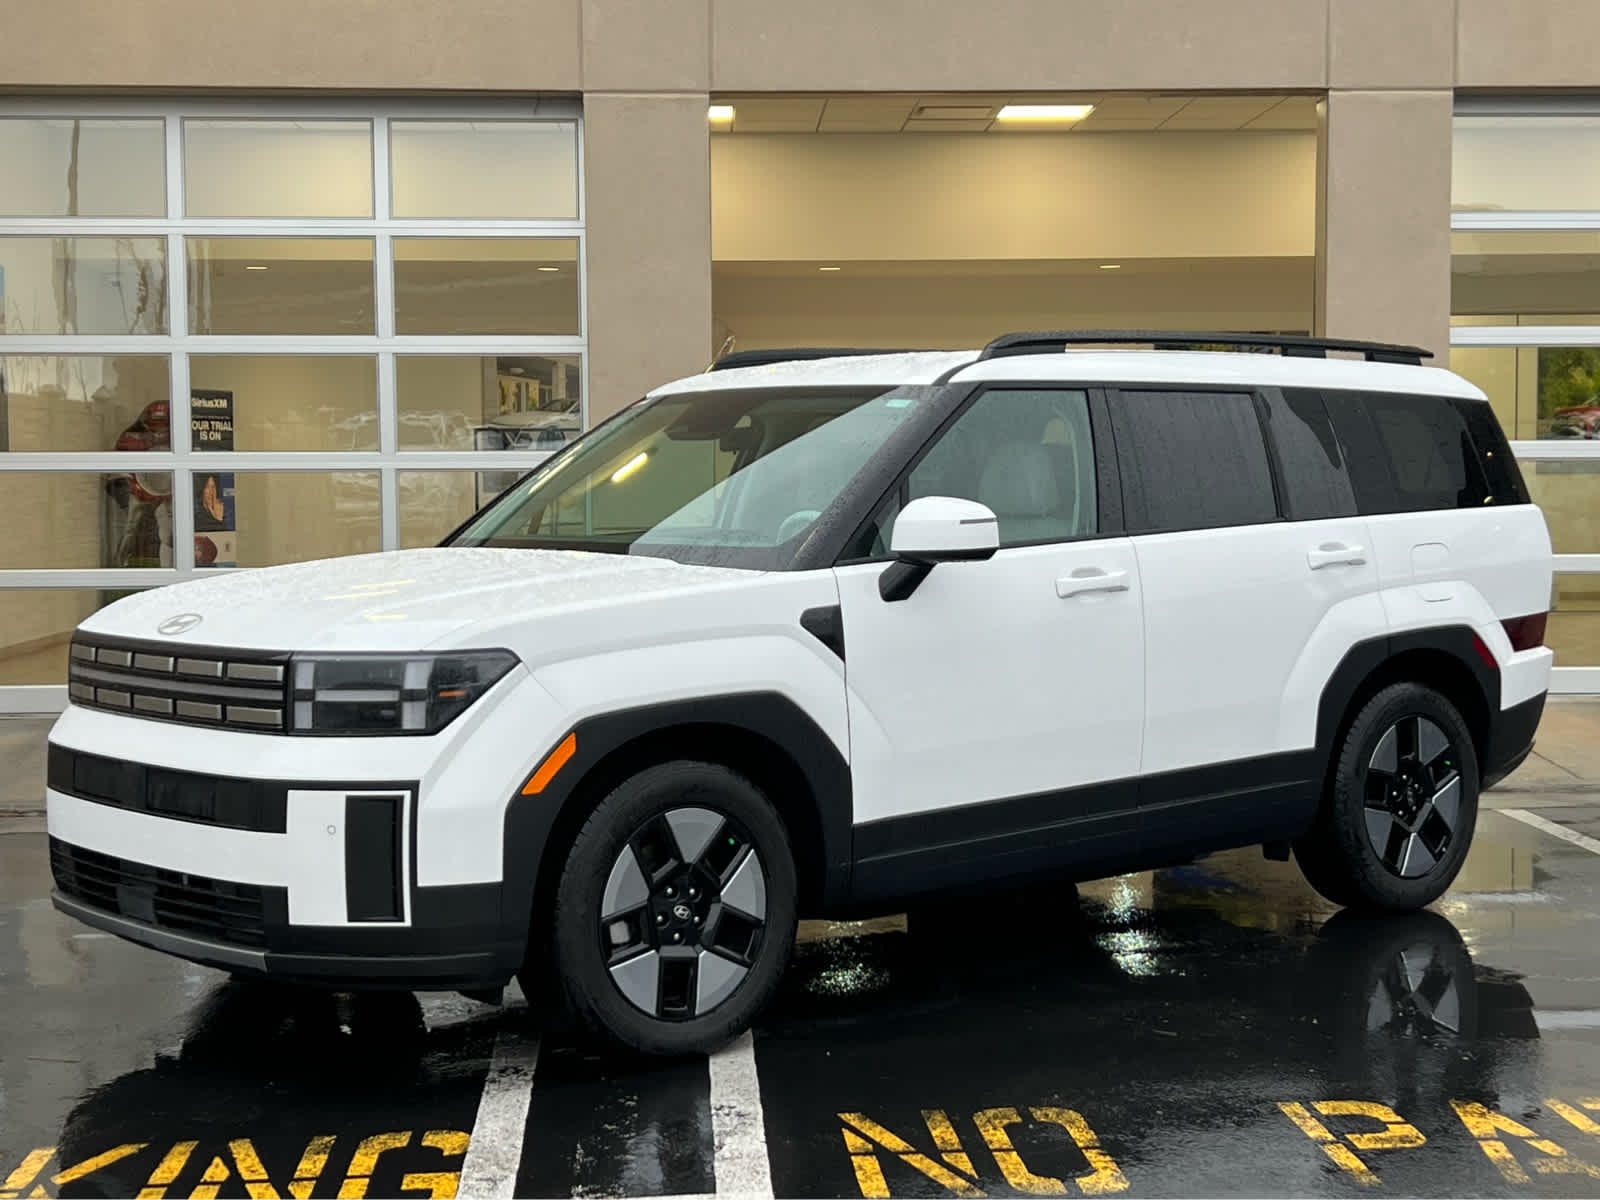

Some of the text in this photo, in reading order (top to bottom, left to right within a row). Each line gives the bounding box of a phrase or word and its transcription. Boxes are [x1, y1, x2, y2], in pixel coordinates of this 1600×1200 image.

[192, 398, 228, 408] SiriusXM
[210, 421, 233, 431] TRIAL
[200, 431, 222, 440] IS ON
[838, 1106, 1129, 1198] NO
